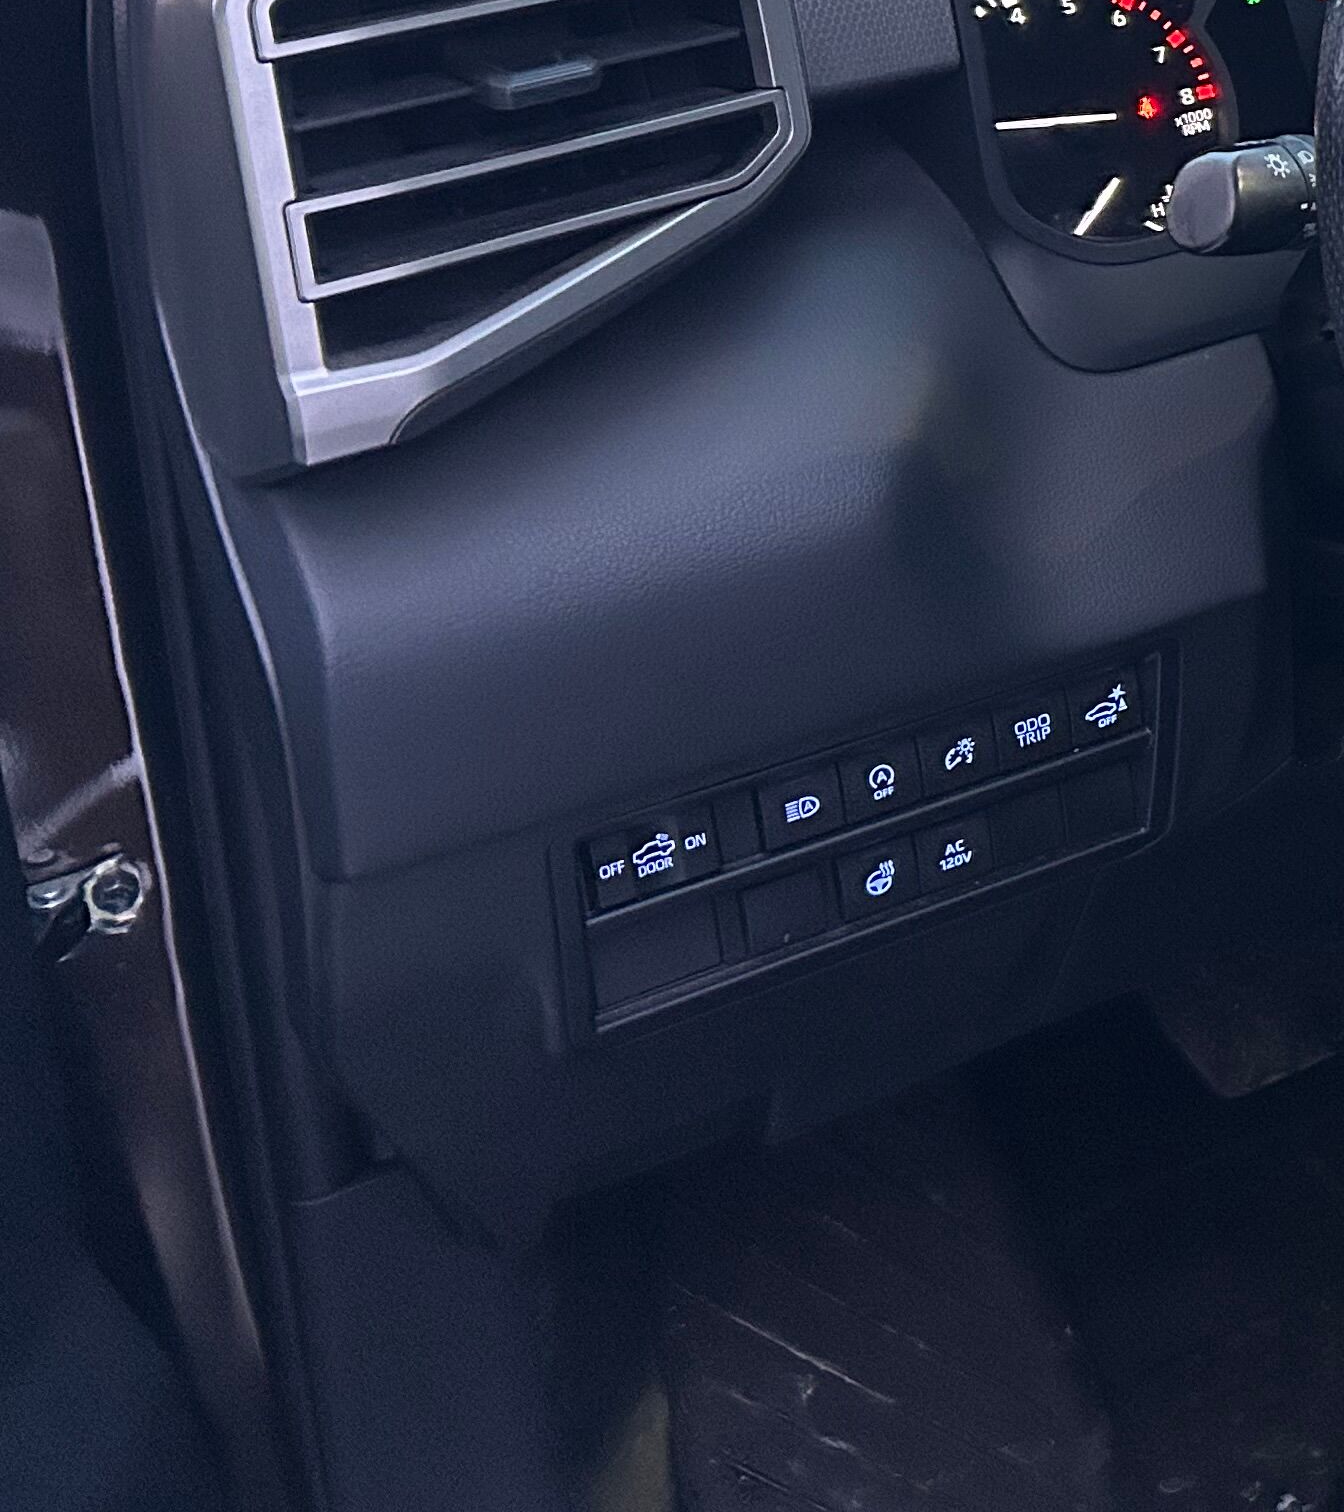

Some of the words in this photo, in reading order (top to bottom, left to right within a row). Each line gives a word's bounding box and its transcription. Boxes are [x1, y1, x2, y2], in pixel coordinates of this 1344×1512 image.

[1010, 7, 1027, 25] 4
[1112, 10, 1127, 27] 6
[1152, 45, 1166, 64] 7
[1179, 87, 1195, 106] 8
[1174, 108, 1214, 128] x1000
[1181, 119, 1211, 136] RPM
[1150, 202, 1166, 218] H
[1013, 713, 1052, 737] ODO
[1098, 714, 1117, 728] OFF
[1016, 726, 1051, 747] TRIP
[873, 786, 895, 801] OFF
[598, 859, 625, 880] OFF
[684, 832, 707, 851] ON
[944, 839, 965, 856] AC
[637, 856, 674, 878] DOOR
[939, 850, 973, 871] 120V
